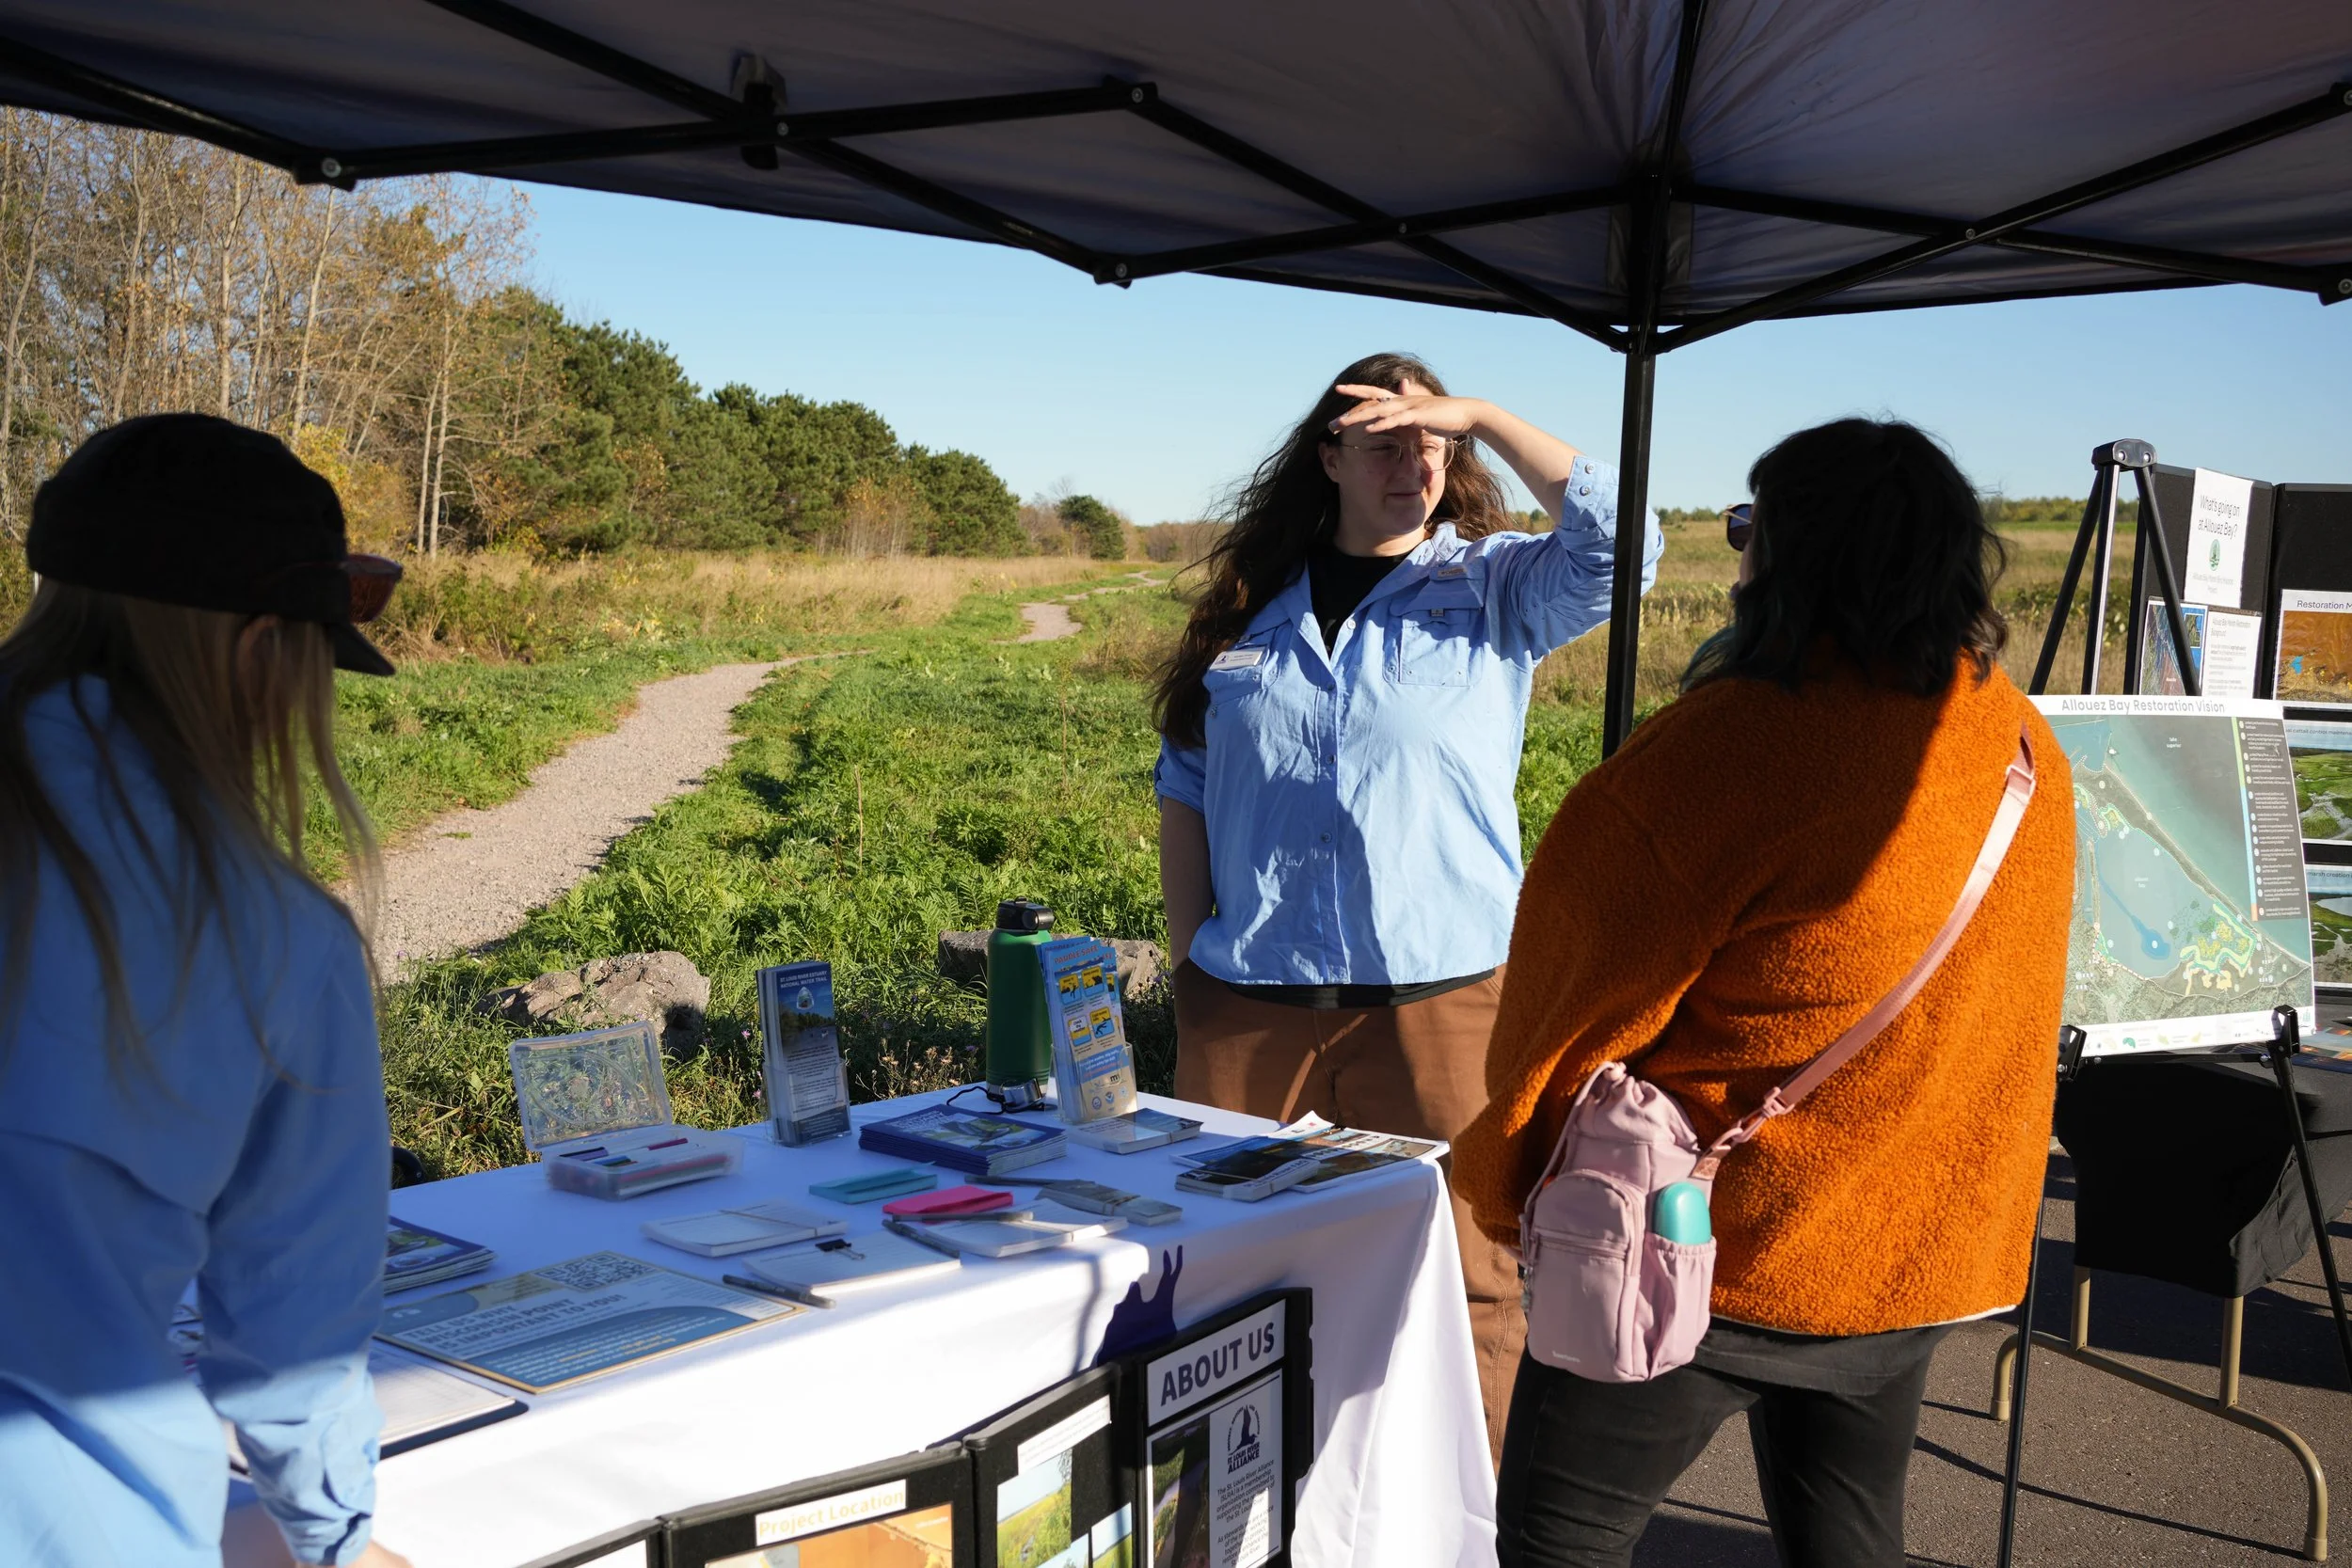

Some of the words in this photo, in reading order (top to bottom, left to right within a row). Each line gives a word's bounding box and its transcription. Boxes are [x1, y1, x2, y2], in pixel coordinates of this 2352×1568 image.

[2200, 495, 2217, 512] What's
[2218, 499, 2232, 519] going
[2233, 505, 2240, 516] on
[2198, 519, 2204, 531] at
[2204, 519, 2224, 535] Allouez
[2224, 522, 2238, 540] Bay?
[2297, 600, 2344, 609] Restoration
[2062, 699, 2106, 711] Allouez
[2109, 700, 2130, 715] Bay
[2134, 699, 2193, 712] Restoration
[2196, 700, 2225, 713] Vision
[1054, 950, 1080, 964] PADDLE
[1081, 945, 1098, 956] SAFE
[403, 1323, 446, 1338] TELL
[477, 1305, 517, 1318] WHY
[420, 1312, 519, 1344] WISCONSIN
[519, 1298, 575, 1317] POINT
[435, 1338, 459, 1350] IS
[461, 1313, 557, 1344] IMPORTANT
[559, 1305, 586, 1316] TO
[586, 1293, 628, 1309] YOU!
[1161, 1338, 1242, 1407] ABOUT
[1248, 1322, 1275, 1361] US
[1228, 1448, 1260, 1475] ALLIANCE
[1233, 1449, 1246, 1461] LOUIS
[1247, 1442, 1260, 1453] RIVER
[1218, 1487, 1226, 1496] The
[1233, 1477, 1245, 1488] Louis
[1246, 1470, 1257, 1481] River
[1257, 1460, 1274, 1474] Alliance
[1244, 1469, 1272, 1488] membership
[1216, 1491, 1245, 1513] organization
[1246, 1477, 1269, 1497] committed
[759, 1511, 823, 1537] Project
[830, 1490, 904, 1521] Location
[1217, 1501, 1242, 1521] supporting
[1242, 1497, 1251, 1507] the
[1226, 1512, 1235, 1523] the
[1224, 1524, 1244, 1540] stewards
[1225, 1539, 1244, 1556] together
